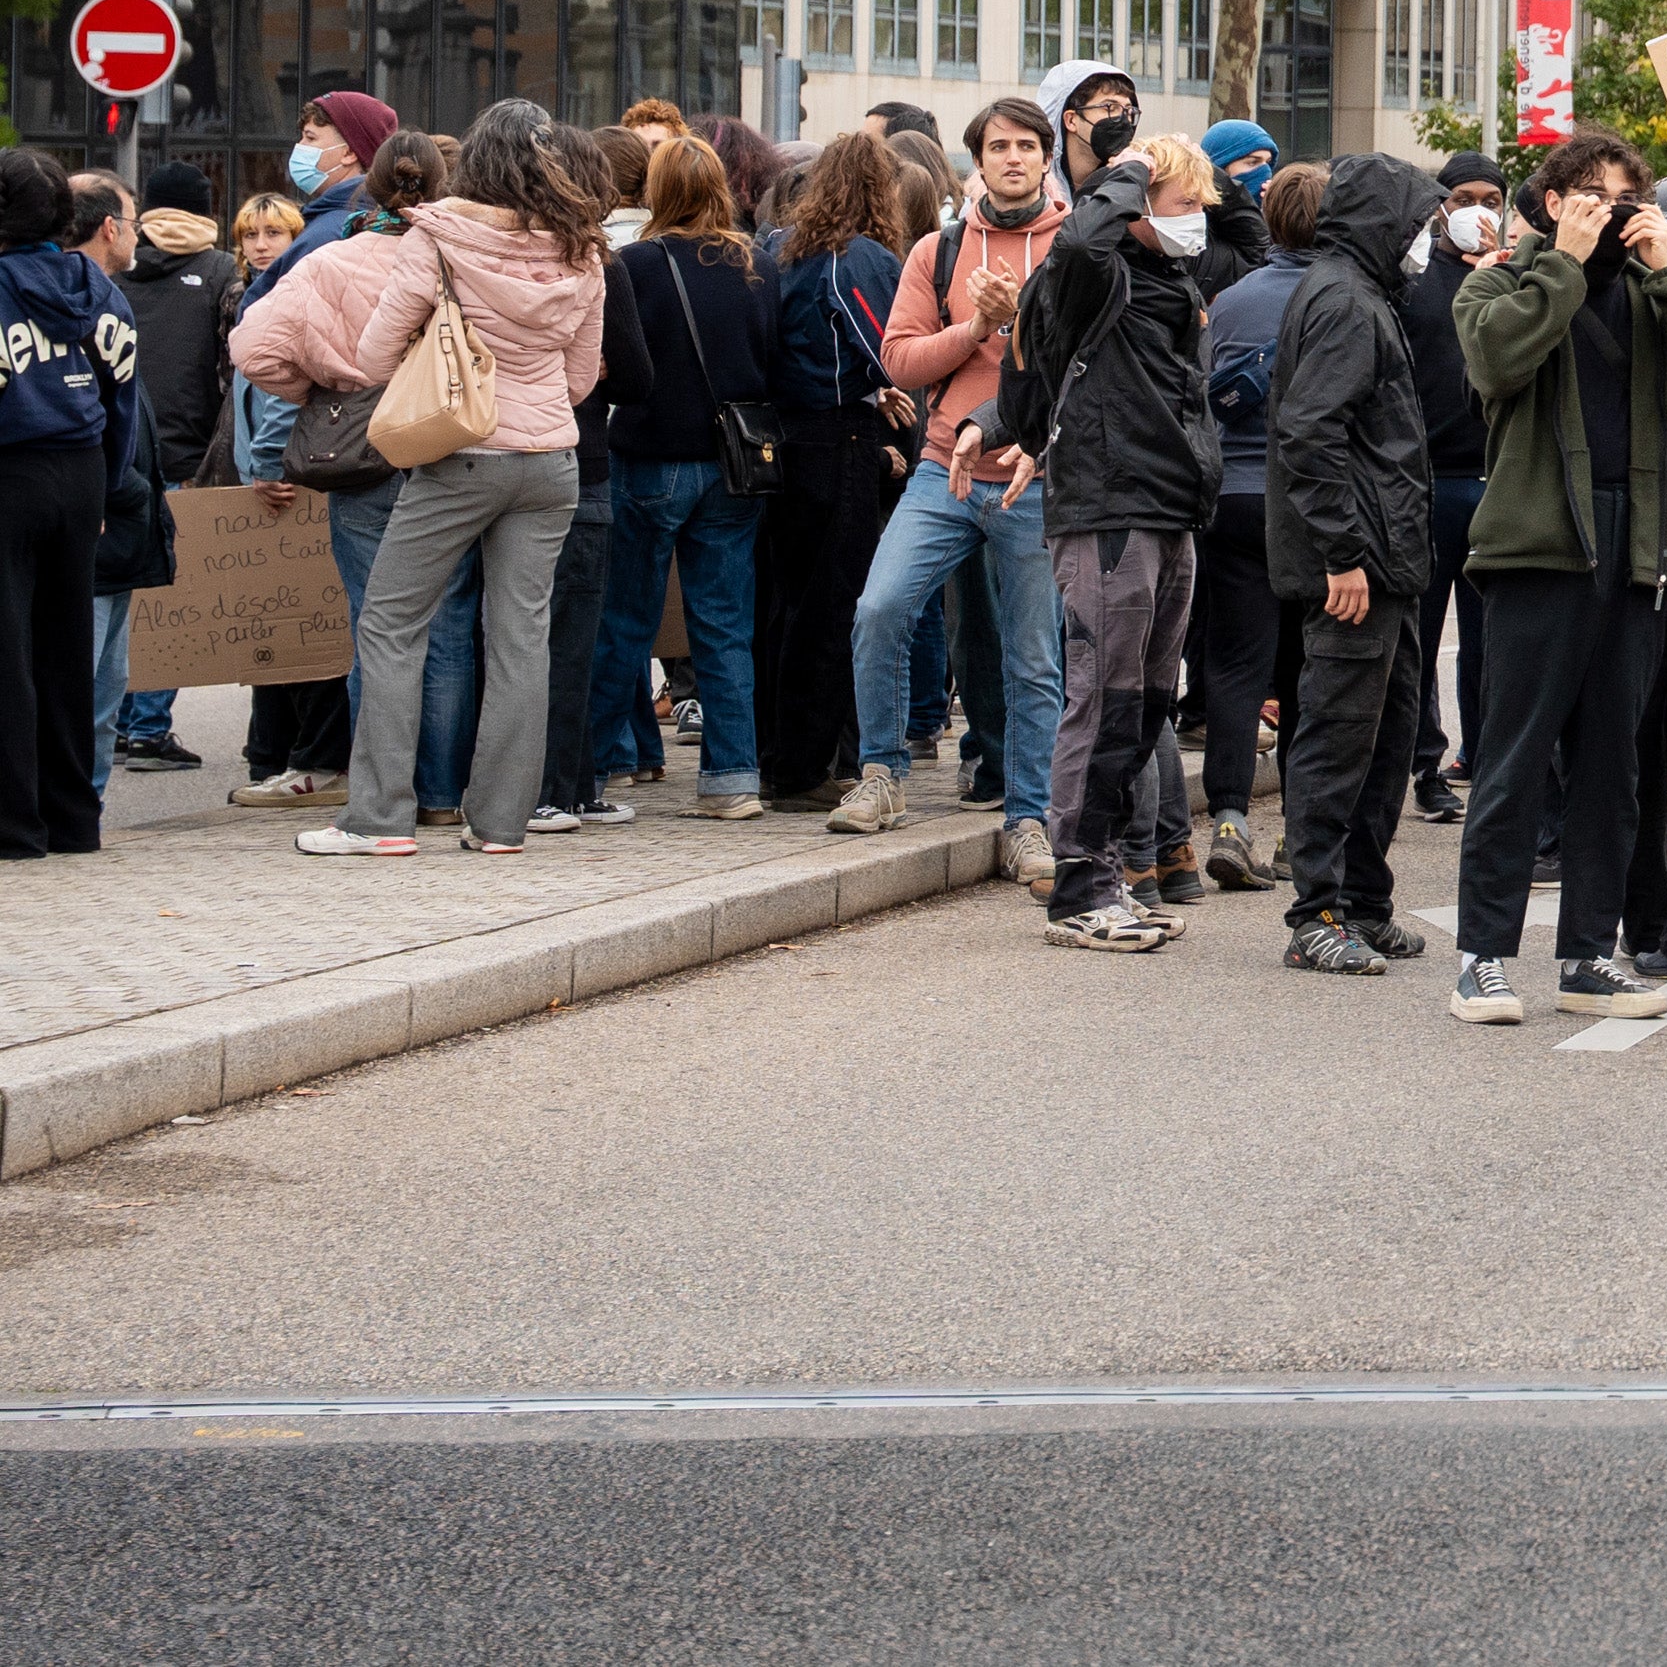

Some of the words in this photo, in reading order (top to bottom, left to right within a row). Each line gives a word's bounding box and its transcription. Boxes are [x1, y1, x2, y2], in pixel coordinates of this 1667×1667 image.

[203, 547, 268, 573] nous
[133, 598, 202, 632] Alors
[211, 586, 301, 619] désolé
[207, 617, 277, 655] parler
[299, 611, 349, 646] plus
